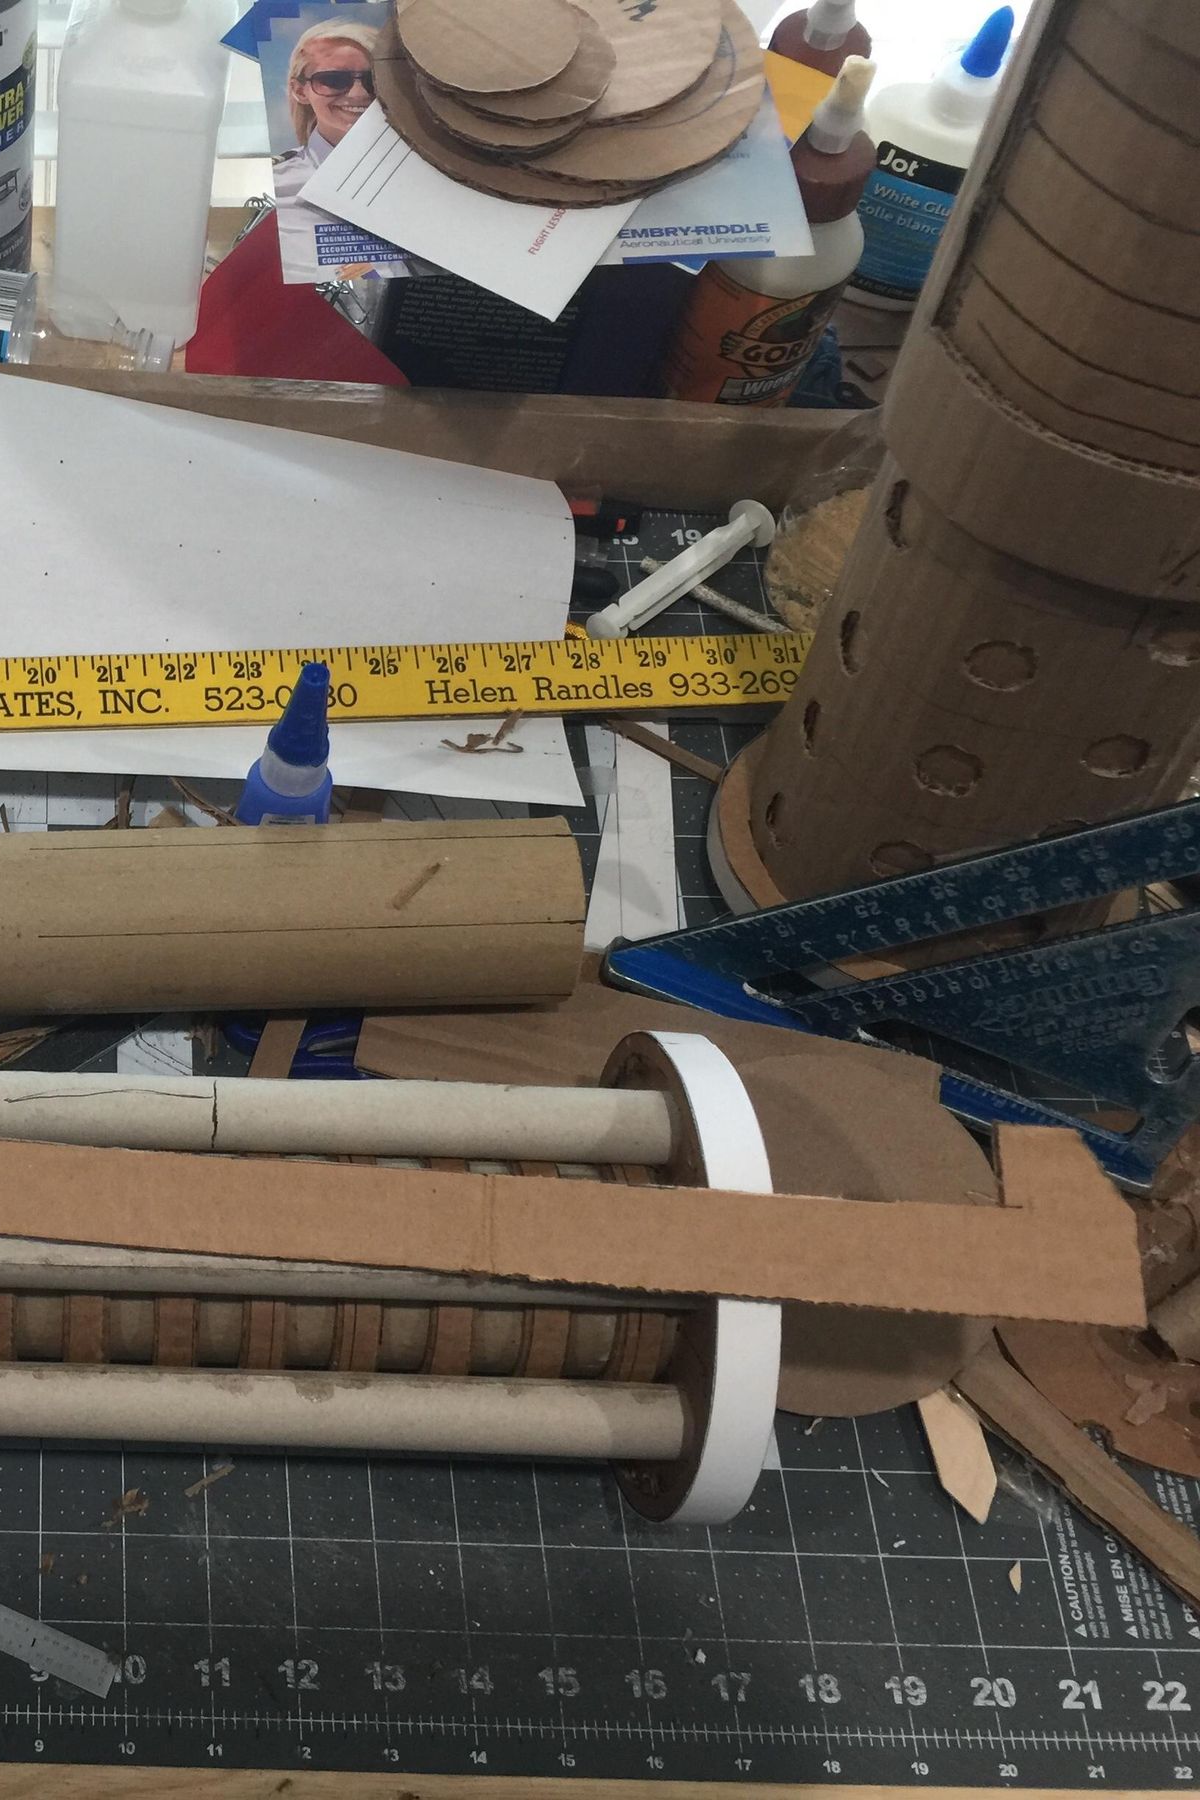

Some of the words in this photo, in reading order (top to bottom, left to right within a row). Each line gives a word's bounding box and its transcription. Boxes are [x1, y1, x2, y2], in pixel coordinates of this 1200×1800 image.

[879, 149, 919, 177] Jot
[873, 183, 919, 208] White
[923, 201, 951, 217] Glu
[618, 222, 771, 240] EMBRY-RIDDLE
[857, 200, 894, 222] Colle
[896, 215, 942, 236] blanc
[528, 229, 551, 256] FLIGHT
[619, 238, 703, 249] Aeronautical
[708, 235, 772, 247] University
[321, 255, 368, 265] COMPUTERS
[671, 529, 703, 546] 19
[27, 667, 57, 684] 20
[96, 665, 126, 683] 21
[164, 663, 196, 680] 22
[232, 661, 263, 678] 23
[368, 658, 399, 675] 25
[437, 657, 467, 673] 26
[503, 655, 533, 672] 27
[571, 652, 601, 669] 28
[638, 651, 667, 668] 29
[706, 648, 736, 665] 30
[774, 646, 801, 664] 31
[99, 688, 170, 714] INC.
[425, 679, 518, 704] Helen
[532, 675, 654, 701] Randles
[668, 670, 799, 698] 933-269
[1110, 1558, 1125, 1580] EN
[1058, 1554, 1083, 1621] CAUTION
[1115, 1584, 1135, 1623] MISE
[114, 1655, 147, 1685] 0
[194, 1656, 231, 1688] 11
[277, 1658, 320, 1690] 12
[365, 1660, 407, 1692] 13
[456, 1666, 494, 1695] 14
[538, 1666, 581, 1697] 15
[625, 1668, 667, 1700] 16
[711, 1671, 752, 1702] 17
[799, 1672, 842, 1705] 18
[885, 1675, 928, 1706] 19
[970, 1676, 1017, 1708] 20
[1057, 1678, 1103, 1710] 21
[1142, 1680, 1192, 1712] 22
[33, 1738, 44, 1752] 9
[118, 1741, 136, 1755] 10
[206, 1743, 224, 1757] 11
[469, 1750, 488, 1765] 14
[557, 1752, 576, 1768] 15
[646, 1754, 664, 1770] 16
[734, 1757, 753, 1772] 17
[823, 1759, 842, 1775] 18
[911, 1761, 930, 1776] 19
[999, 1763, 1018, 1778] 20
[1088, 1764, 1106, 1779] 21
[1174, 1765, 1194, 1780] 22
